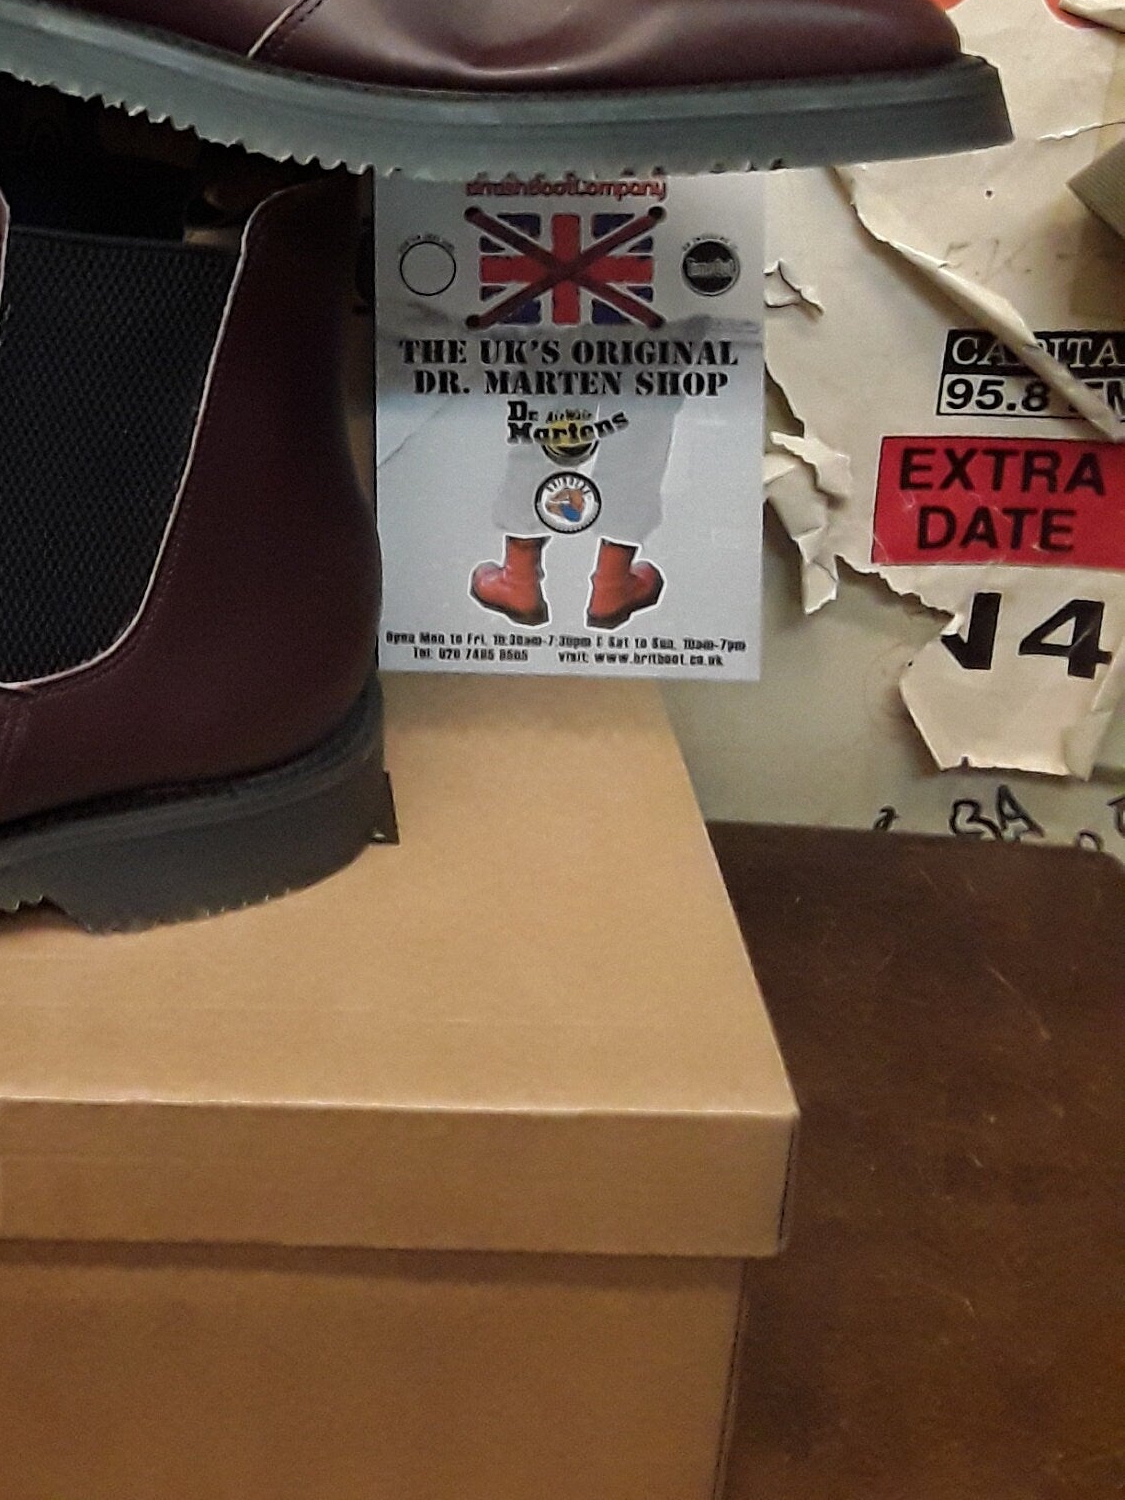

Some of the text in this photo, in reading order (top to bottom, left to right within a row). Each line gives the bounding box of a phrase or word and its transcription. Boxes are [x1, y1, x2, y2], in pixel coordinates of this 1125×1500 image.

[400, 340, 739, 367] THE UK'S ORIGINAL
[413, 369, 729, 397] DR. MARTEN SHOP
[946, 378, 1050, 412] 95.8
[899, 447, 1105, 496] EXTRA
[918, 506, 1076, 552] DATE
